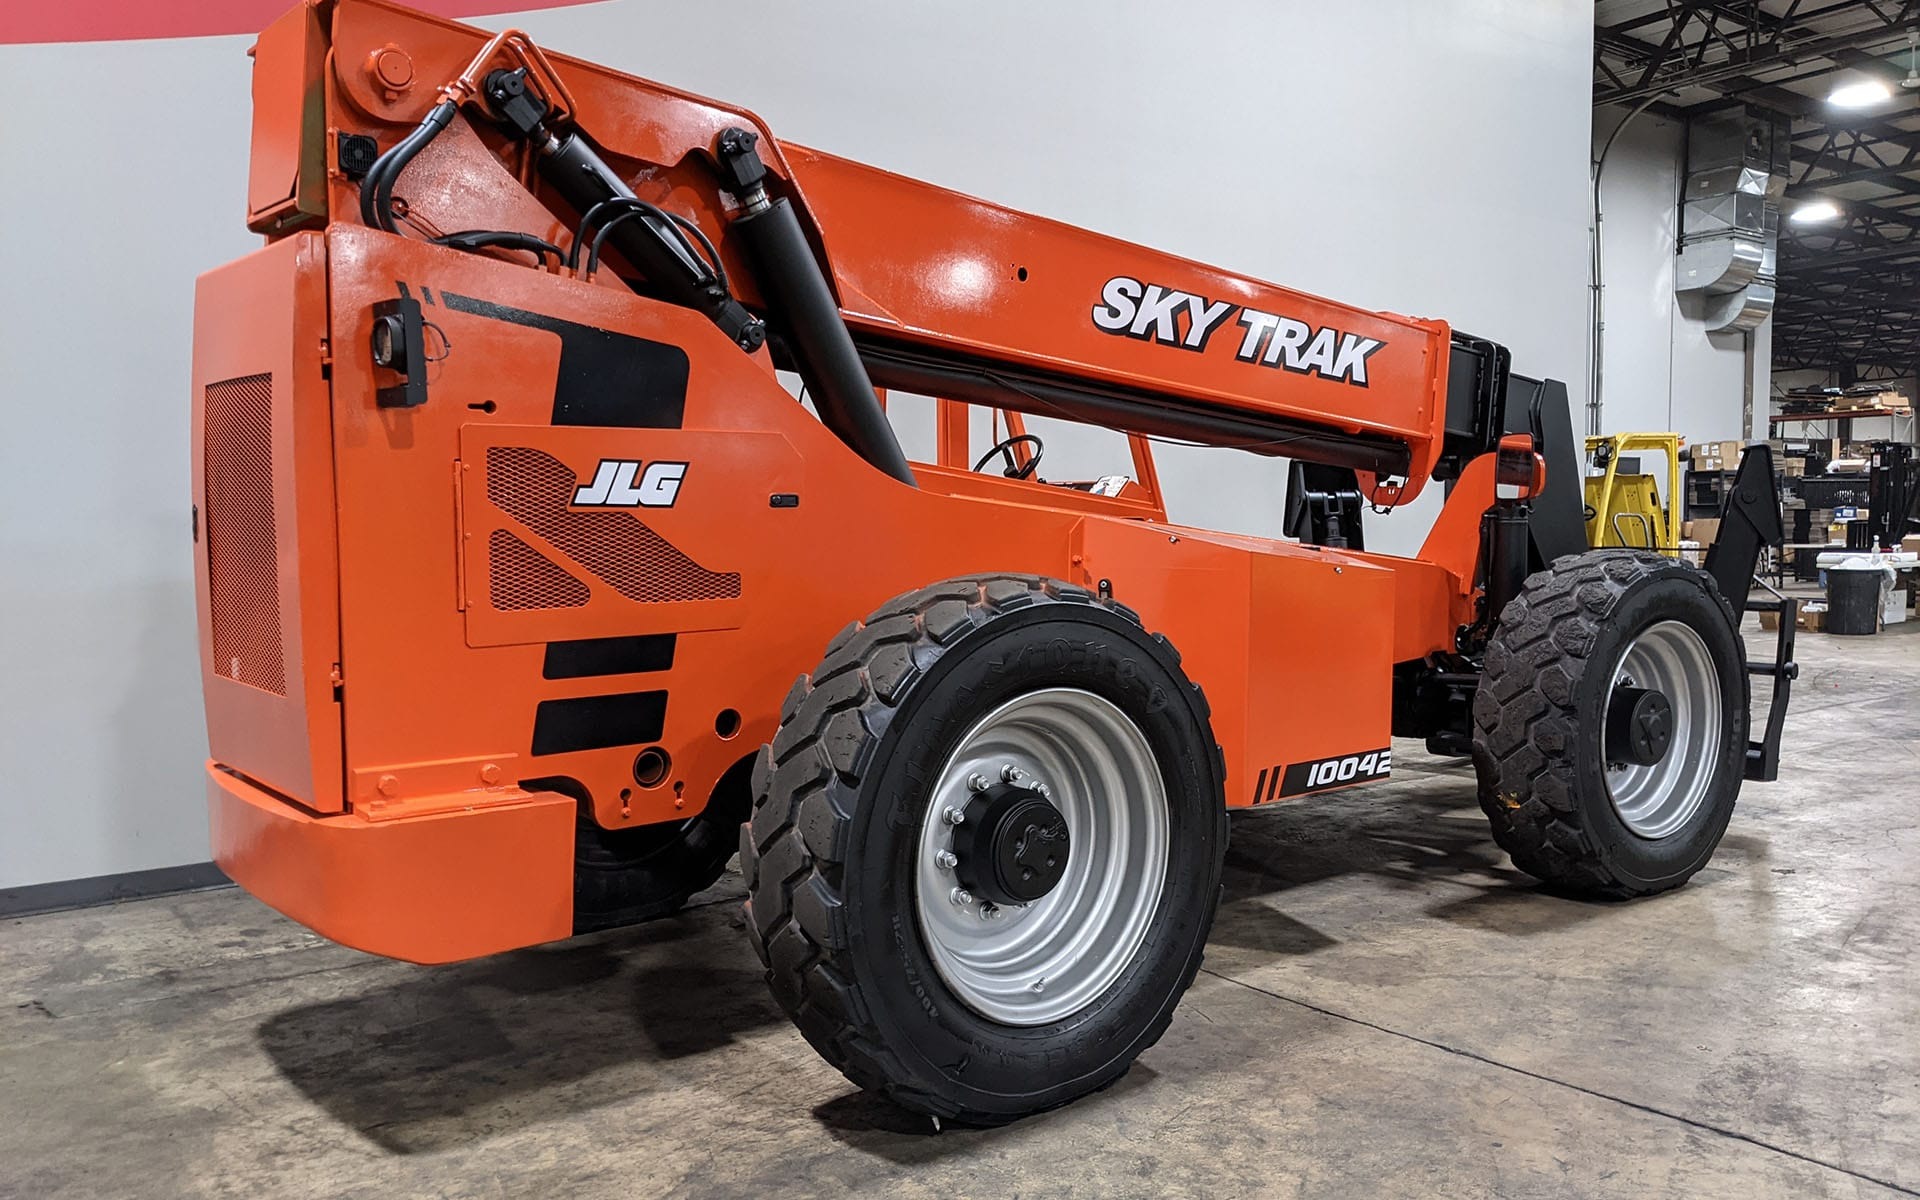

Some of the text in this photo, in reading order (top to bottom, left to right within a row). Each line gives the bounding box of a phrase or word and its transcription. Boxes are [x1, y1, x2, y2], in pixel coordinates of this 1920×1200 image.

[1091, 276, 1387, 387] SKY TRAK
[571, 458, 690, 508] JLG
[1306, 750, 1391, 788] 10042
